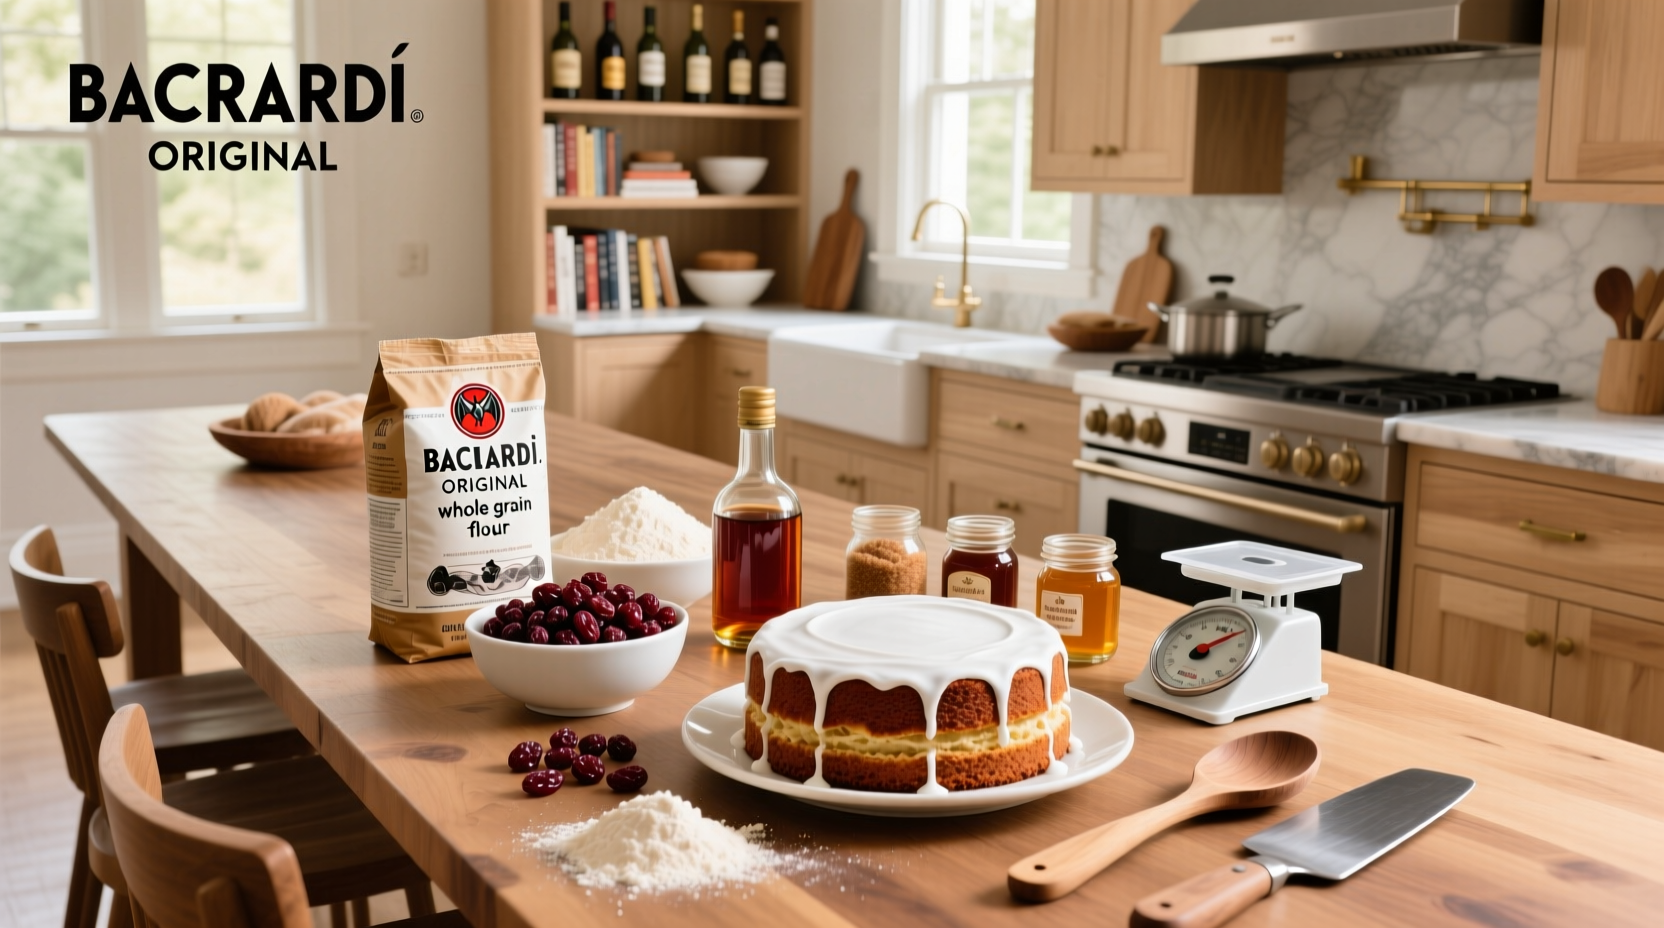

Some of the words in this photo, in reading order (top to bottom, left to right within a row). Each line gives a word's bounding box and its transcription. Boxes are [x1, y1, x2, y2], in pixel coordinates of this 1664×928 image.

[441, 473, 528, 494] ORIGINAL
[438, 498, 489, 519] whole
[493, 496, 532, 518] grain
[467, 520, 510, 538] flour
